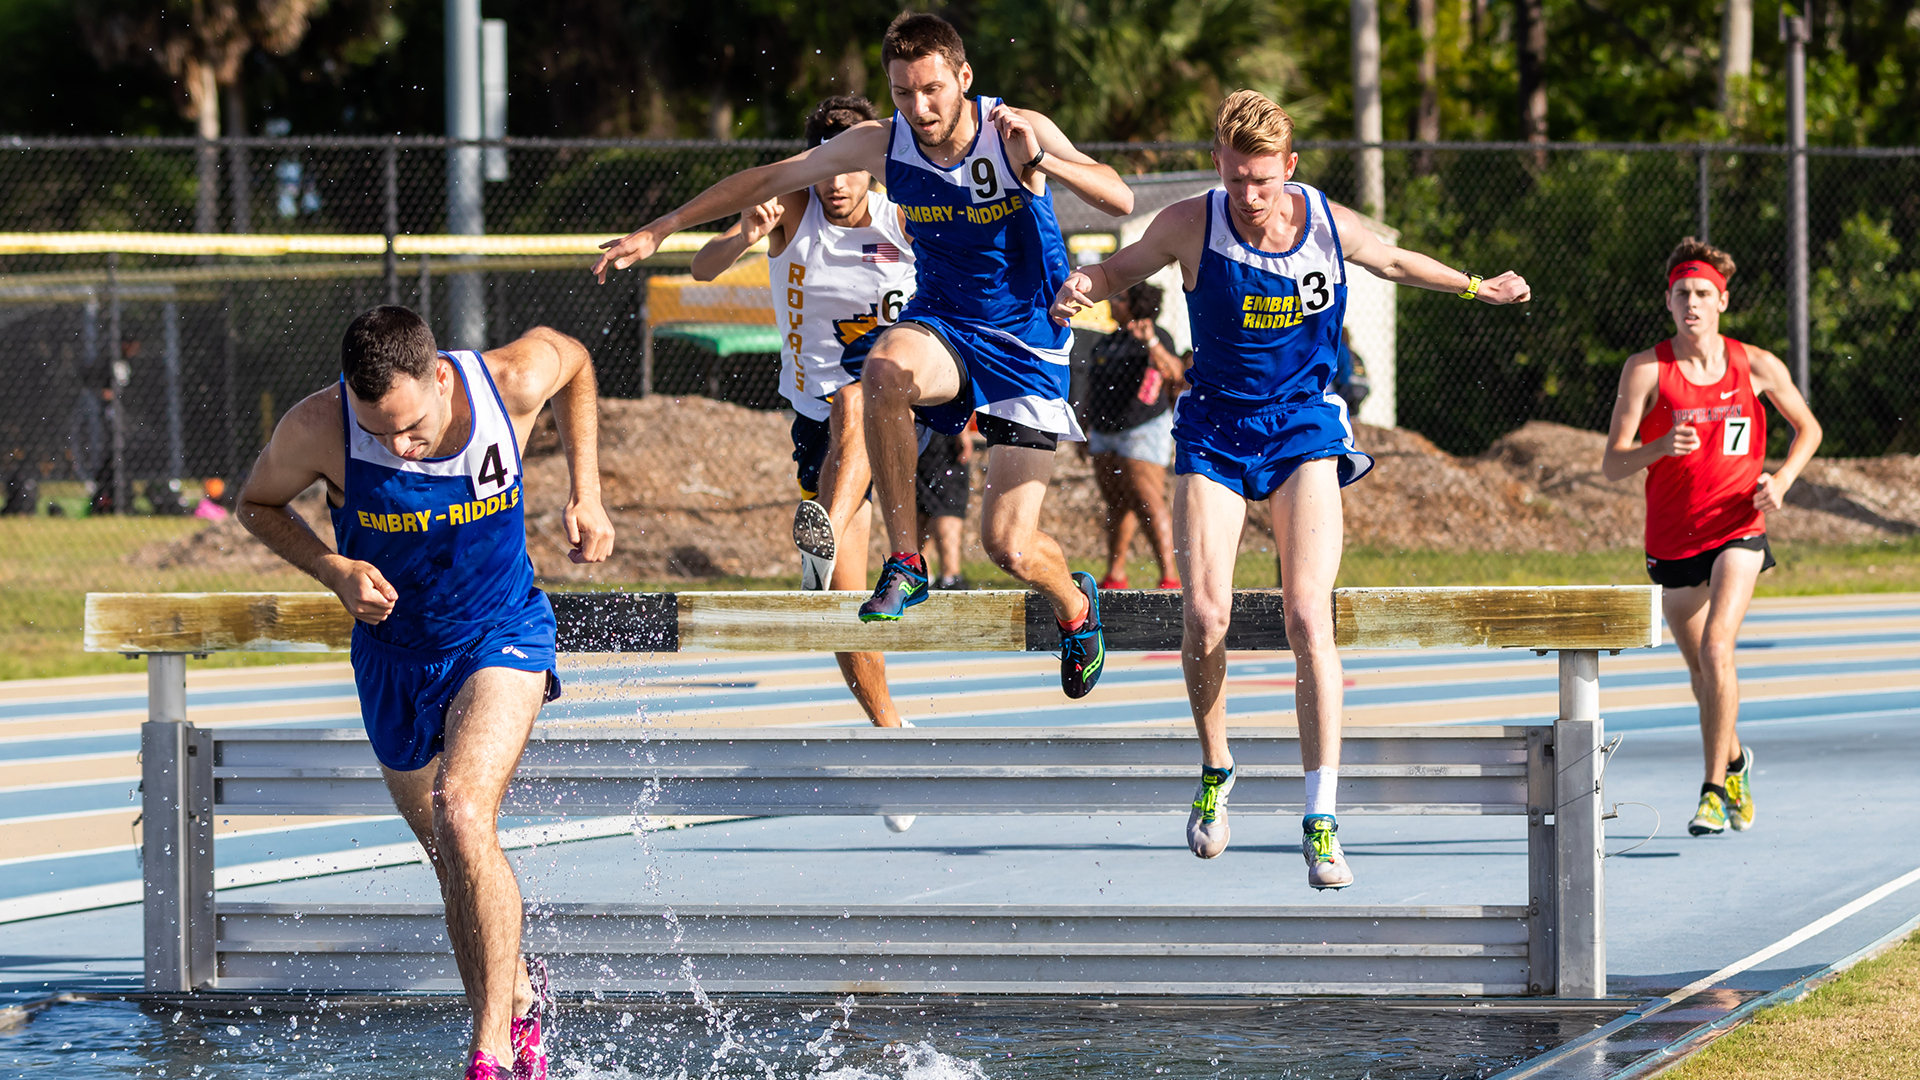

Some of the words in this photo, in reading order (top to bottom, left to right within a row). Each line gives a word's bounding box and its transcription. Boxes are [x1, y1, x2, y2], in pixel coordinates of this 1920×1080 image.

[971, 157, 998, 199] 9
[881, 289, 904, 323] 6
[1241, 295, 1302, 312] EMBRY
[1302, 271, 1330, 311] 3
[787, 261, 806, 393] ROYALS
[1242, 312, 1304, 329] RIDDLE
[1729, 422, 1746, 451] 7
[477, 442, 508, 489] 4
